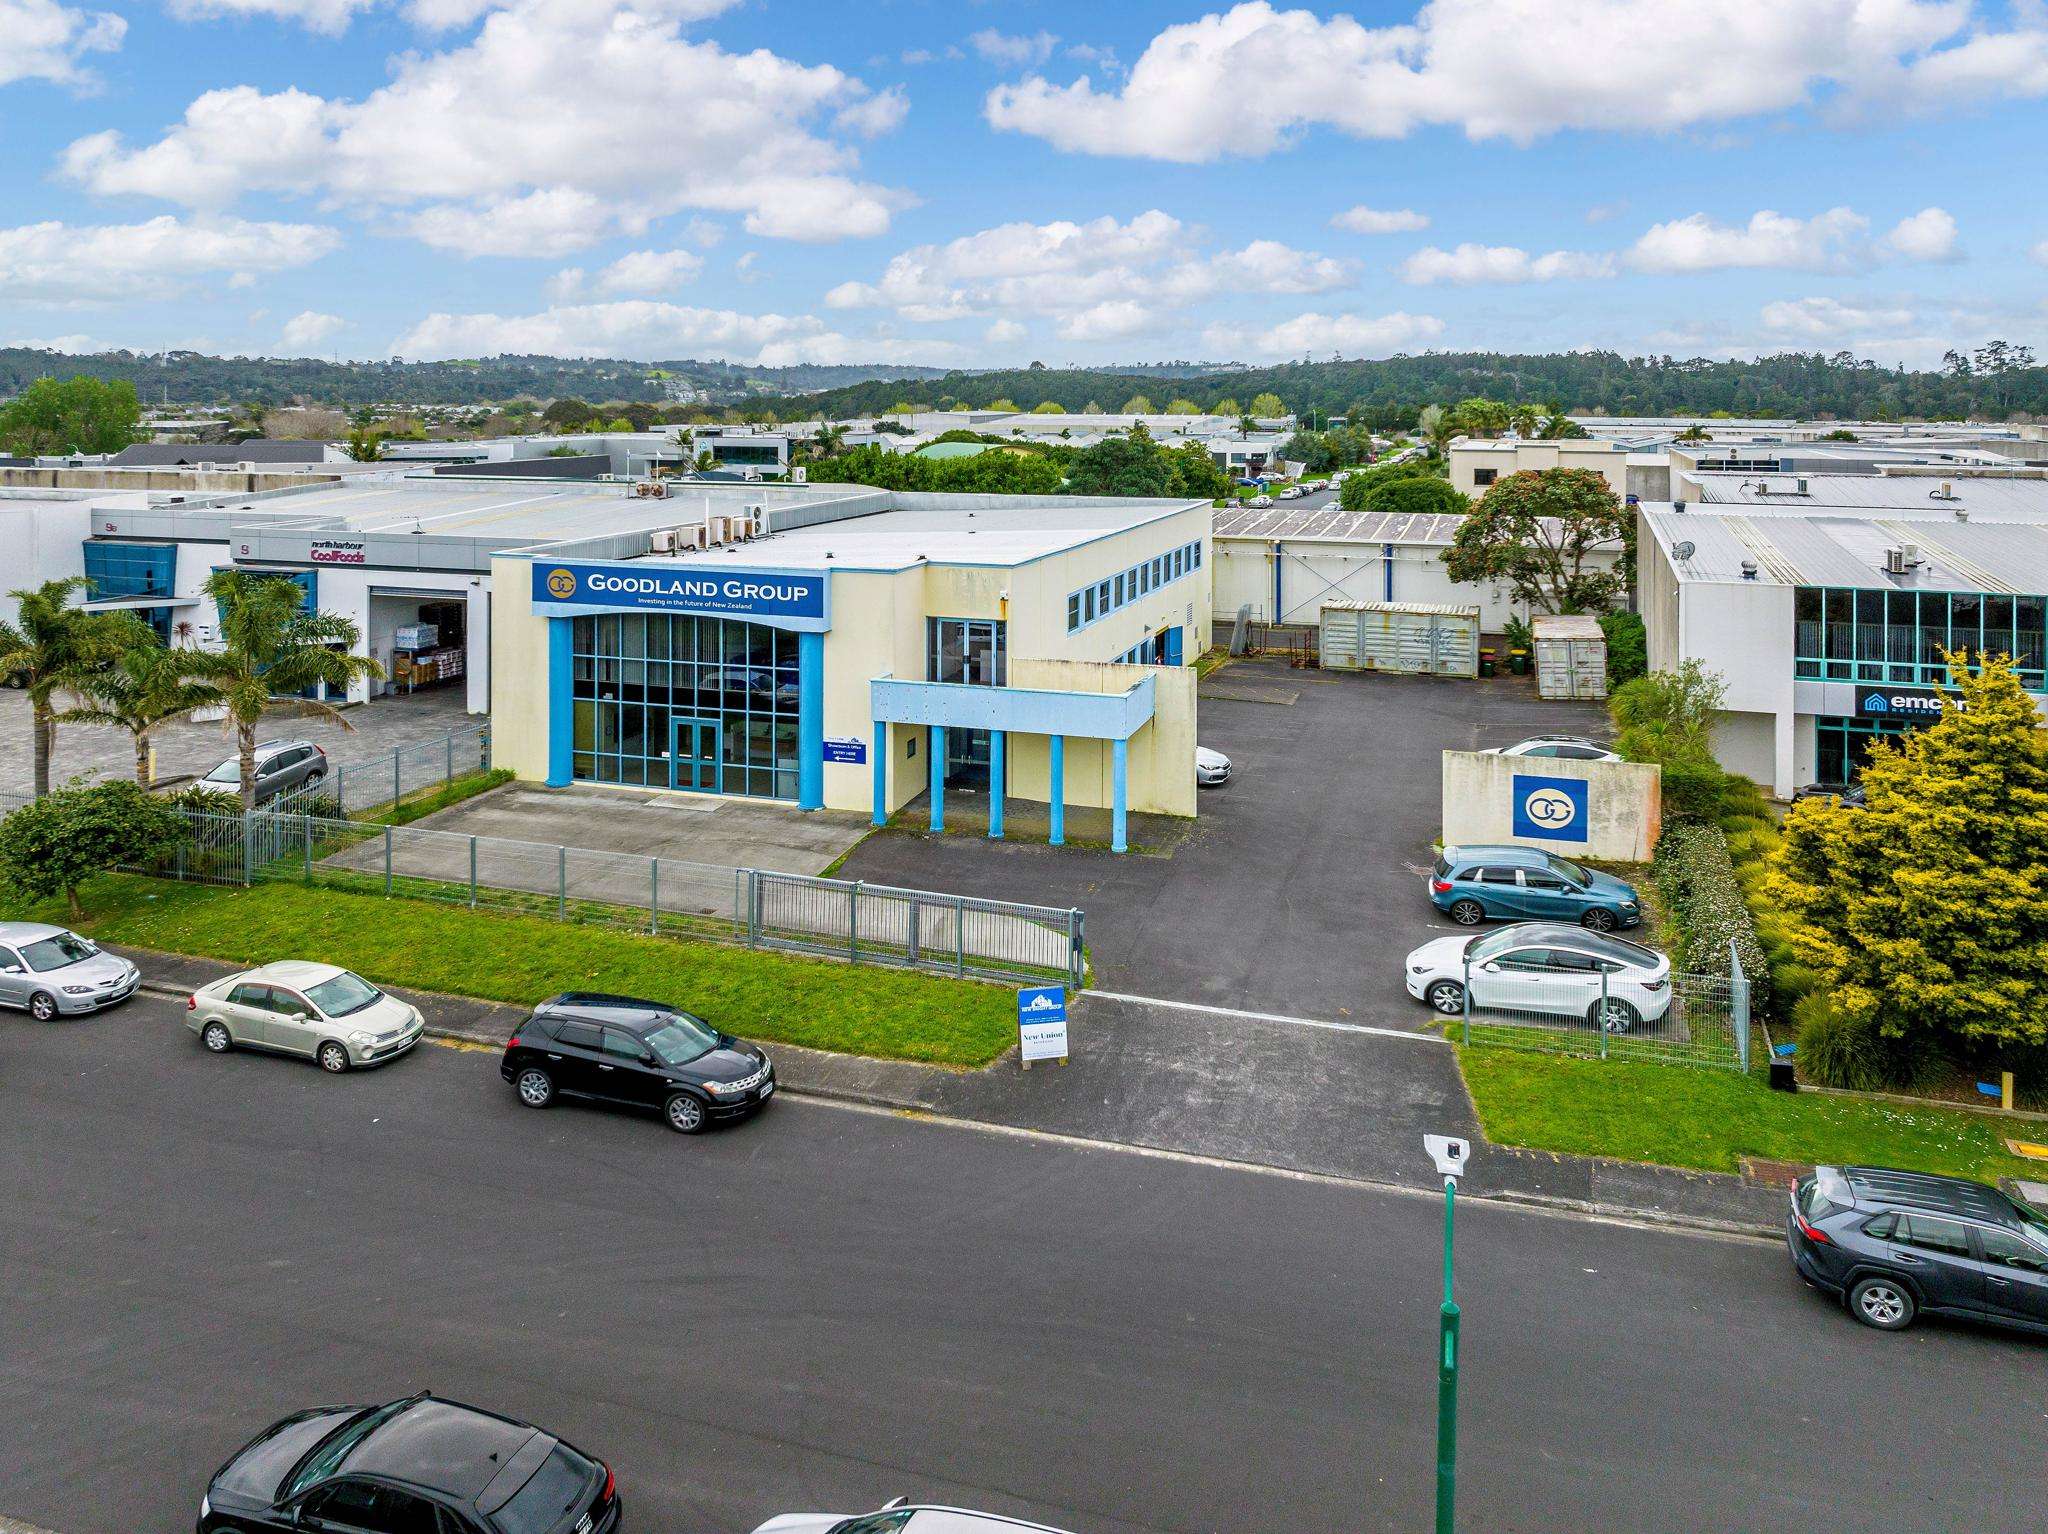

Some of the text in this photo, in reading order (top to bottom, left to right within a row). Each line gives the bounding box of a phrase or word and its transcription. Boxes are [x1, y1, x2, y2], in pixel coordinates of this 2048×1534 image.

[311, 541, 364, 550] north harbour
[311, 550, 365, 563] CoolFoods
[587, 573, 809, 602] GOODLAND GROUP
[637, 597, 666, 606] Investing
[727, 602, 753, 610] Zealand
[1023, 1031, 1064, 1041] New Union
